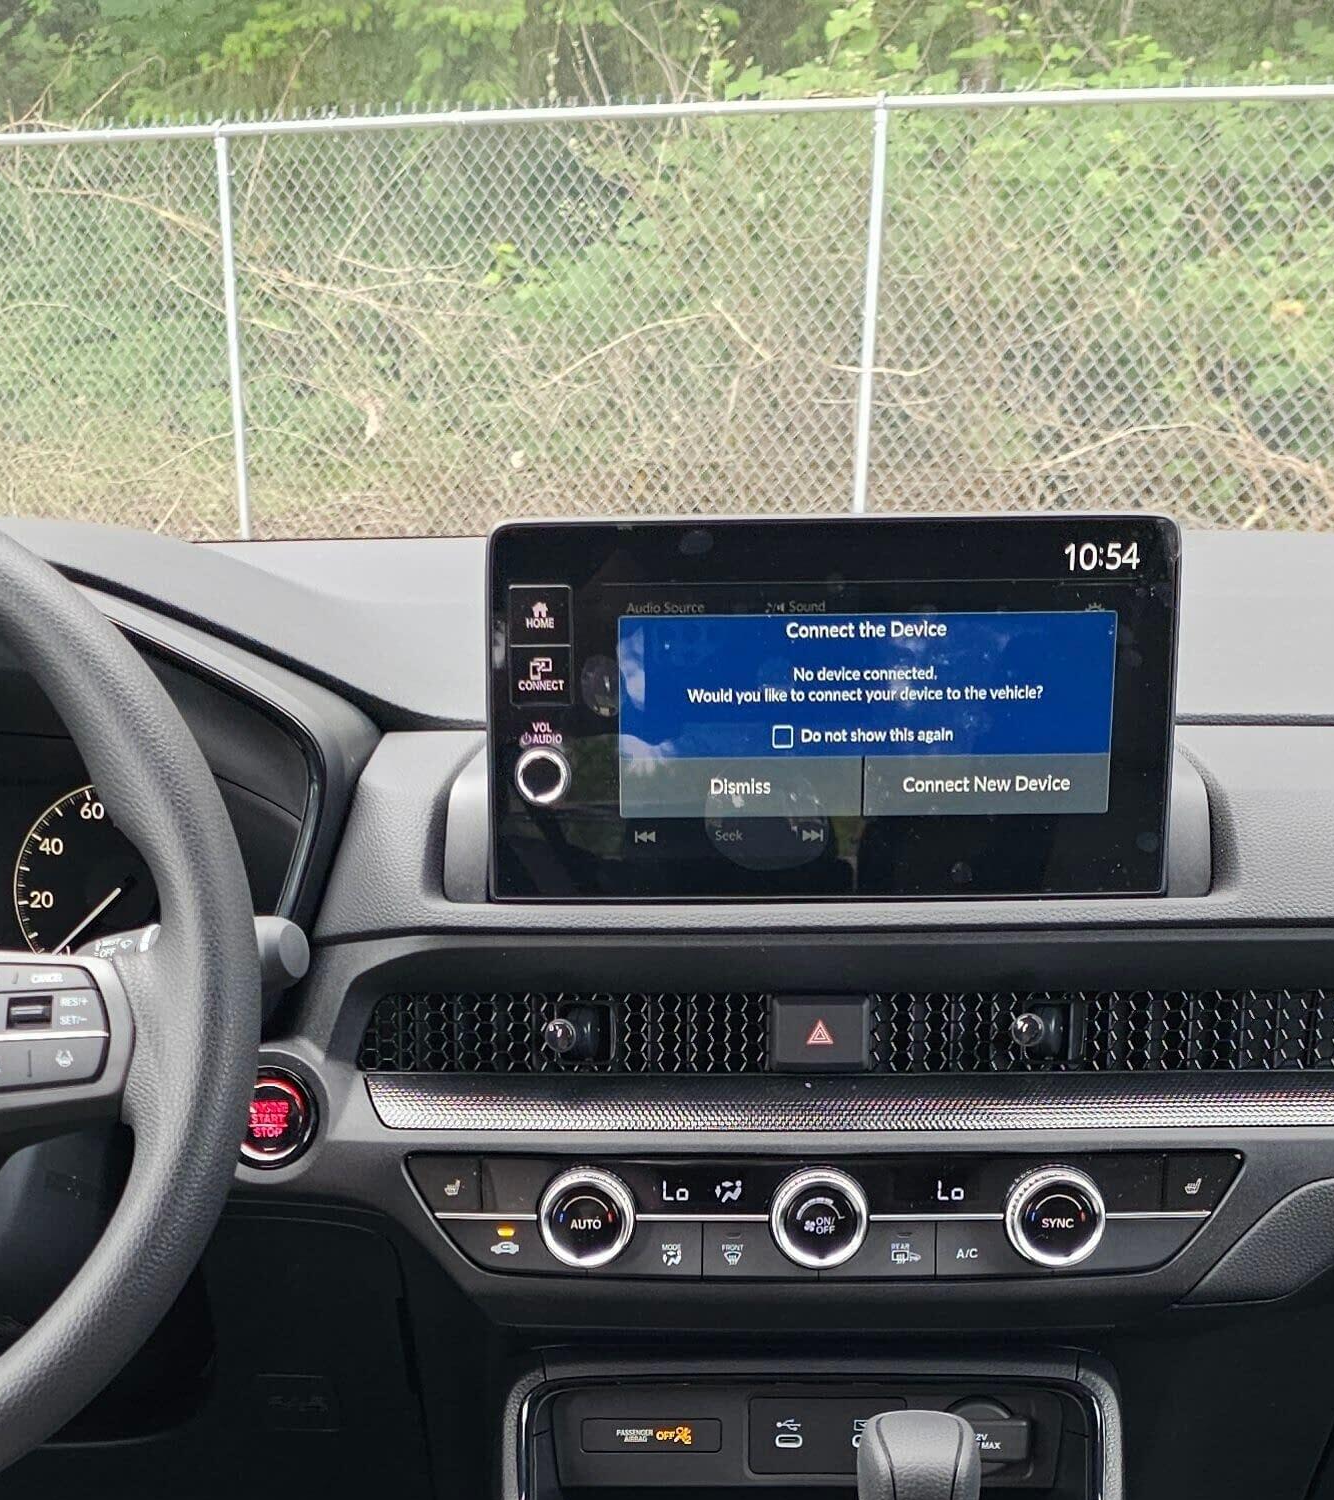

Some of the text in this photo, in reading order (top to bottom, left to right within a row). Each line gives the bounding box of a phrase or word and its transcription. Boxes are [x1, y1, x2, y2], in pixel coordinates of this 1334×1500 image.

[1064, 542, 1141, 571] 10:54
[626, 602, 705, 614] Audio Source
[789, 600, 826, 612] Sound
[525, 617, 555, 629] HOME
[786, 620, 948, 639] Connect the Device
[793, 666, 937, 682] No device connected.
[518, 680, 565, 692] CONNECT
[687, 684, 1044, 705] Would you like to connect your device to the vehicle?
[532, 722, 553, 733] VOL
[532, 734, 563, 745] AUDIO
[801, 726, 954, 745] Do not show this again
[710, 777, 771, 796] Dismiss
[903, 774, 1071, 793] Connect New Device
[80, 802, 105, 820] 60
[715, 828, 743, 842] Seek
[38, 838, 64, 856] 40
[29, 891, 54, 909] 20
[251, 1113, 287, 1124] START
[253, 1127, 283, 1138] STOP
[662, 1180, 689, 1201] Lo
[936, 1180, 965, 1200] Lo
[570, 1218, 602, 1231] AUTO
[1041, 1217, 1075, 1229] SYNC
[816, 1225, 836, 1235] OFF
[661, 1243, 681, 1251] MODE
[721, 1243, 744, 1251] FRONT
[955, 1248, 979, 1260] A/C
[615, 1429, 654, 1437] PASSENGER
[655, 1430, 675, 1441] OFF
[975, 1433, 988, 1441] 2V
[981, 1442, 1002, 1450] MAX
